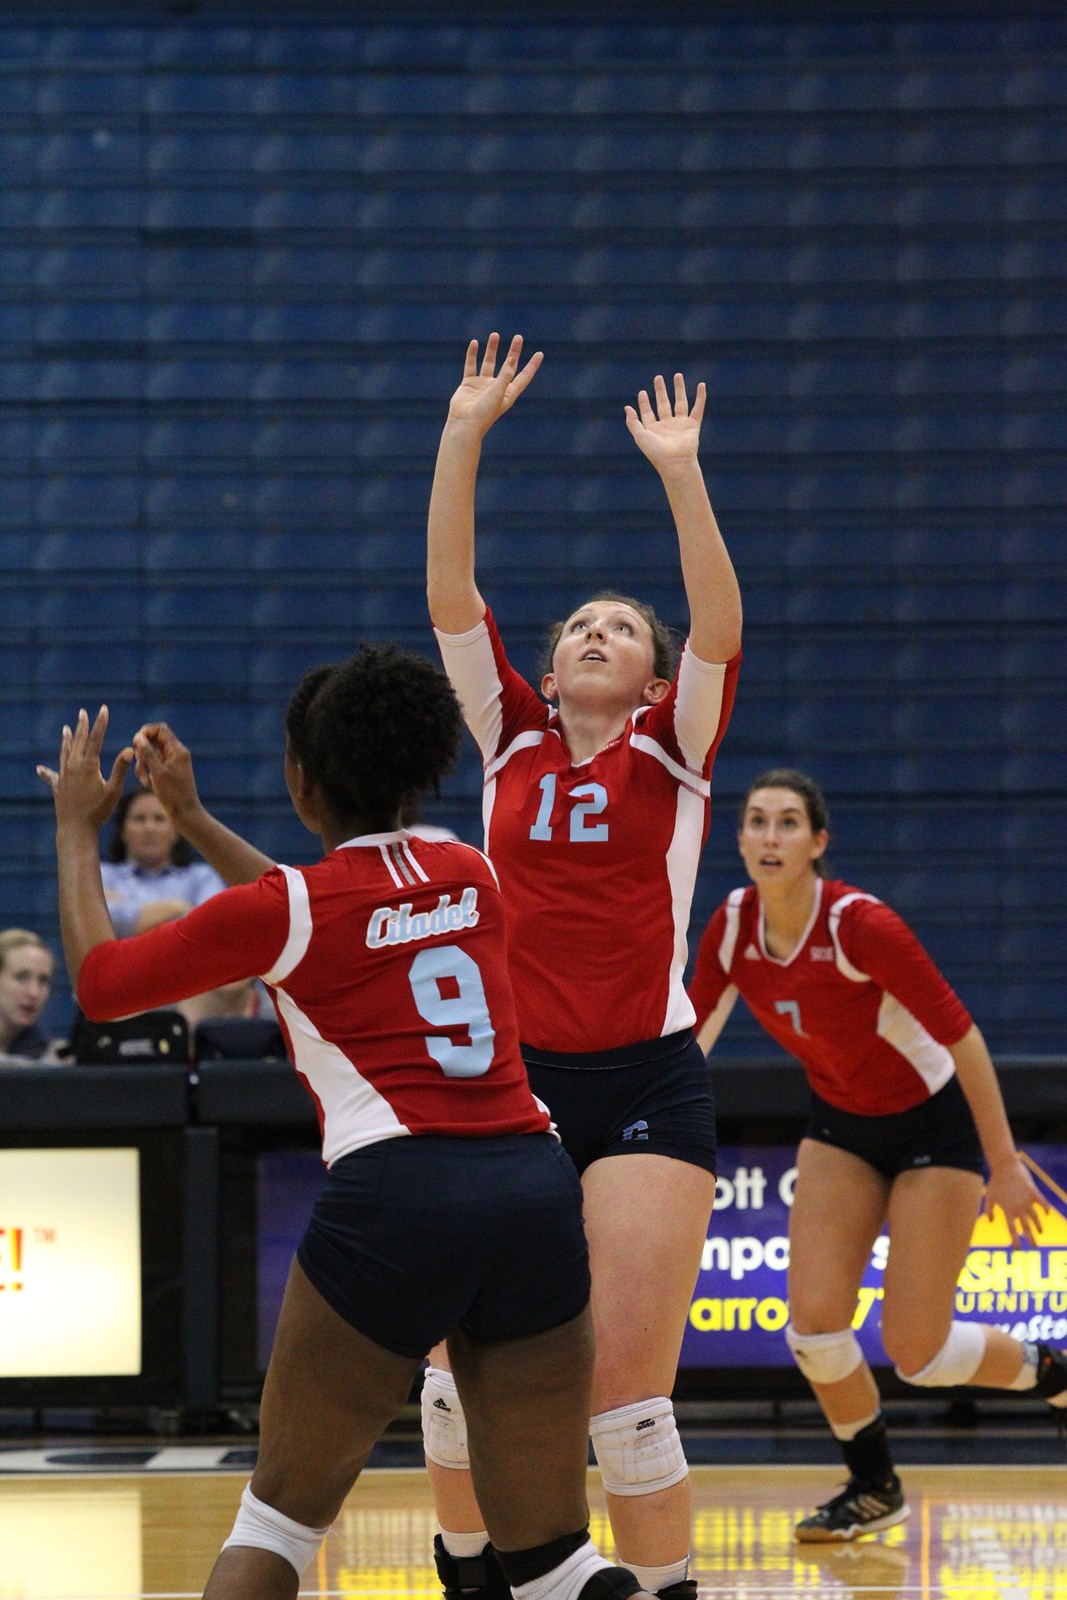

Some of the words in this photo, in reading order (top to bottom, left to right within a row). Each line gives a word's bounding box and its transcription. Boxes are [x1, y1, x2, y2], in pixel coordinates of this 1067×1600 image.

[529, 773, 608, 842] 12
[365, 887, 480, 949] Citadel
[408, 945, 496, 1078] 9
[774, 1000, 810, 1038] 7
